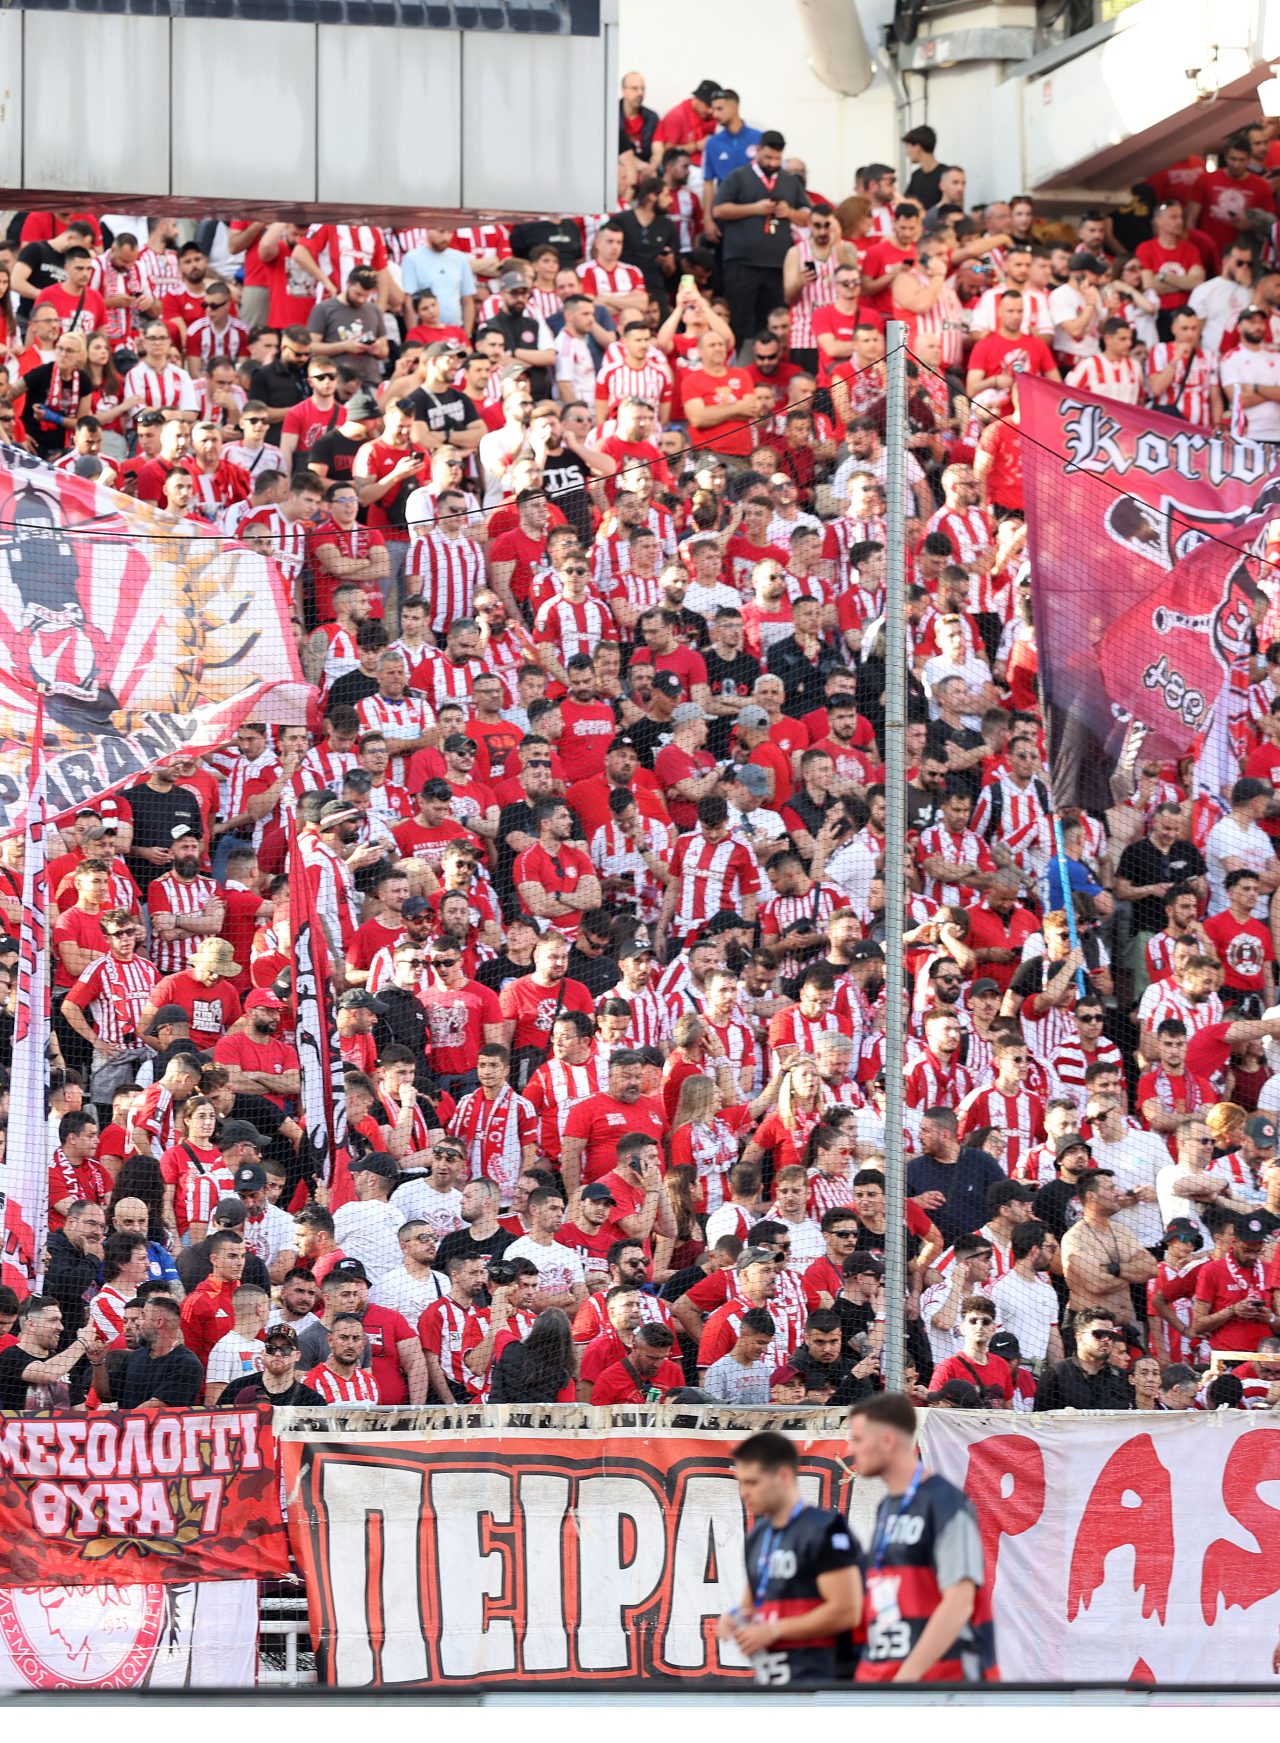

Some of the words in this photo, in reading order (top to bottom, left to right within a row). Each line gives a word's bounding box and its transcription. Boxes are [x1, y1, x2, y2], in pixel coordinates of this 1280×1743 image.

[28, 1480, 177, 1538] ΘΥΡΑ
[189, 1476, 227, 1534] 7
[322, 1461, 885, 1689] ΠΕΙΡΑ
